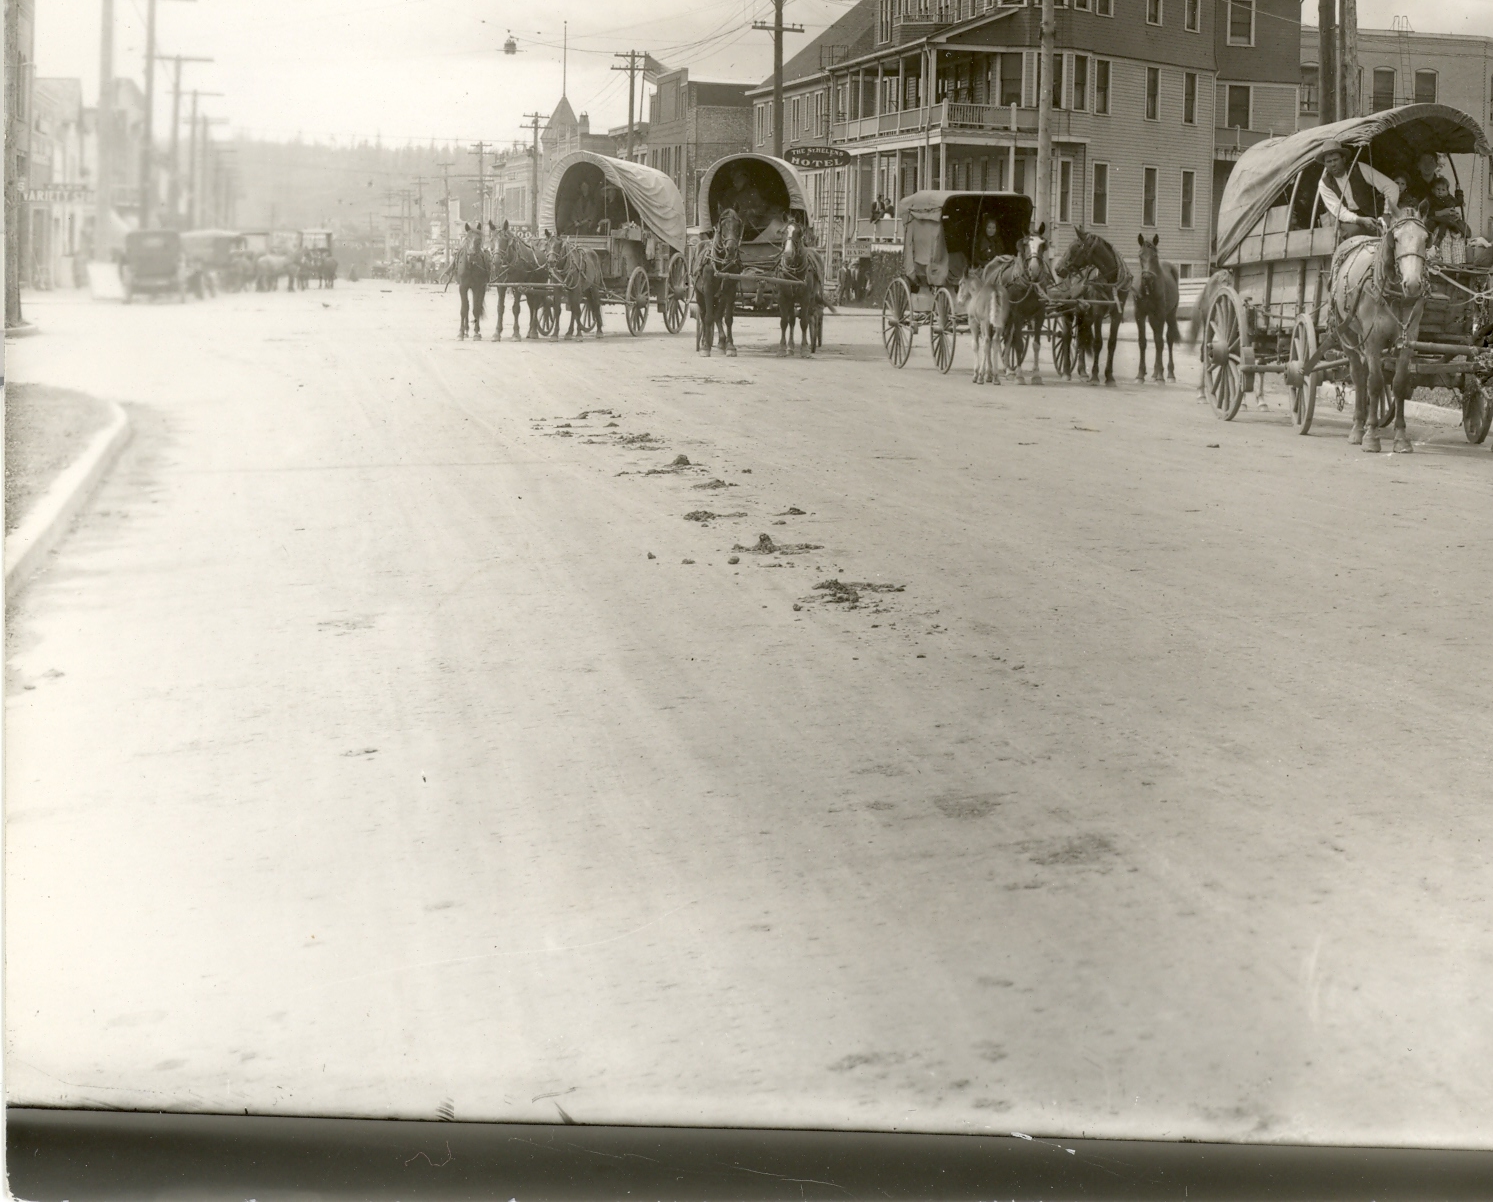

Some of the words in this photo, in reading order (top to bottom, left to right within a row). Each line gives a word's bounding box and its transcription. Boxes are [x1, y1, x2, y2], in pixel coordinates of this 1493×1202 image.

[791, 148, 806, 156] THE
[790, 156, 844, 168] HOTEL
[22, 189, 69, 201] VARIETY
